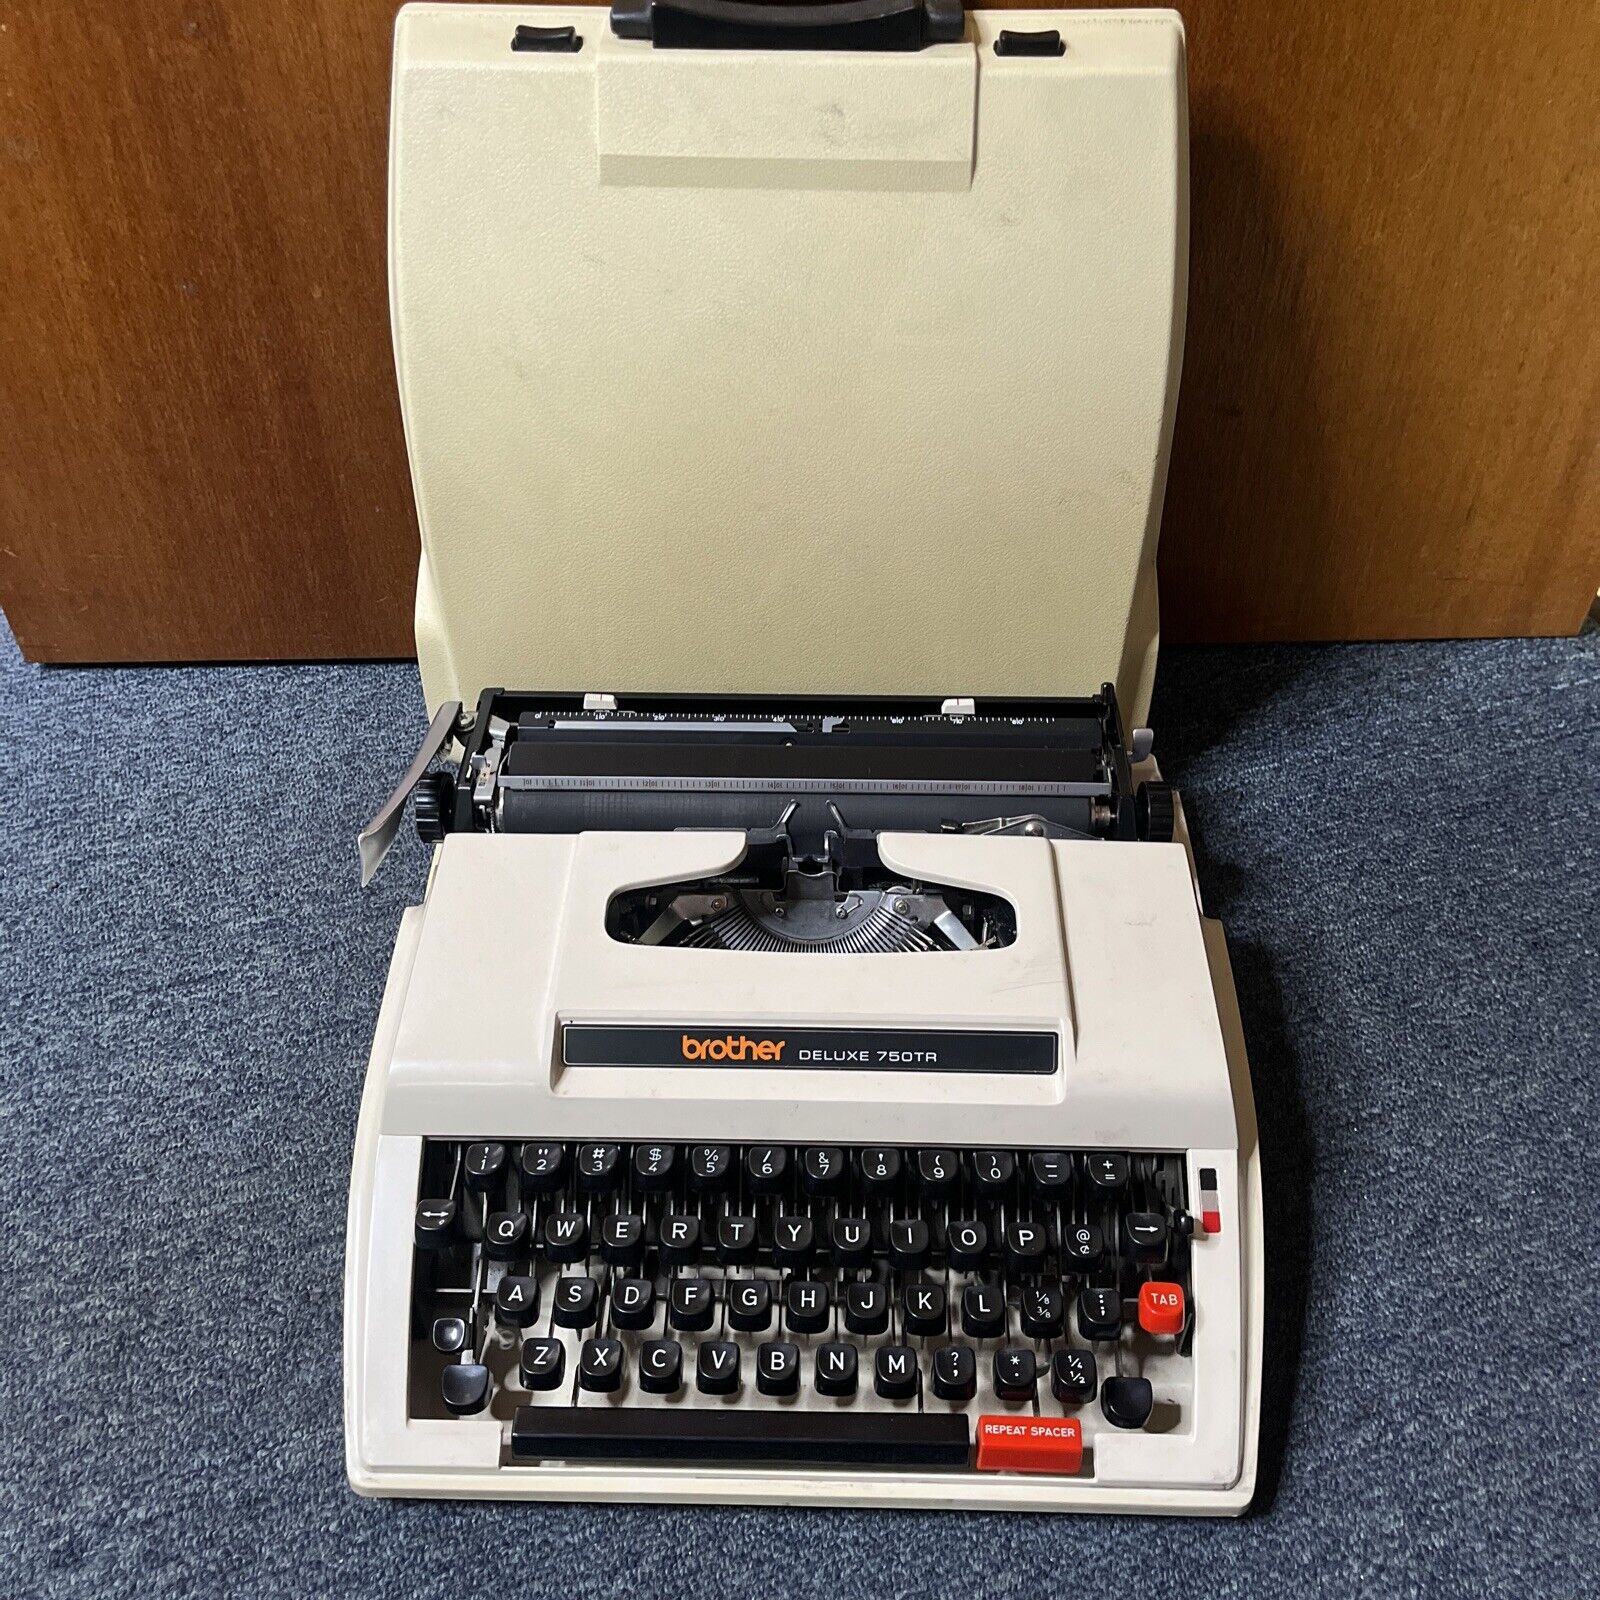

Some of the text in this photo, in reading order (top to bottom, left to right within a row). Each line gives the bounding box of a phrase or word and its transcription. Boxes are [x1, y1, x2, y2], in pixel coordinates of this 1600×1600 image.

[682, 1034, 938, 1063] brother DELUXE 750TR
[649, 1148, 662, 1161] $
[704, 1149, 718, 1161] %
[818, 1152, 830, 1164] &
[536, 1159, 547, 1170] 2
[592, 1161, 603, 1171] 3
[648, 1162, 658, 1172] 4
[706, 1162, 715, 1173] 5
[762, 1163, 773, 1174] 6
[819, 1164, 829, 1175] 7
[876, 1164, 887, 1175] 8
[933, 1168, 945, 1179] 9
[498, 1220, 514, 1237] Q
[556, 1221, 576, 1237] W
[616, 1222, 629, 1238] E
[672, 1222, 687, 1239] R
[731, 1224, 744, 1240] T
[788, 1224, 801, 1241] Y
[845, 1226, 859, 1242] U
[1076, 1229, 1090, 1243] @
[961, 1229, 977, 1246] O
[1018, 1230, 1034, 1246] P
[507, 1285, 523, 1302] A
[568, 1286, 582, 1302] S
[625, 1287, 639, 1304] D
[685, 1288, 697, 1305] F
[742, 1289, 757, 1305] G
[801, 1290, 815, 1308] H
[861, 1291, 873, 1309] J
[918, 1292, 932, 1309] K
[1151, 1292, 1178, 1306] TAB
[978, 1295, 991, 1312] L
[533, 1347, 548, 1365] Z
[593, 1348, 608, 1366] X
[651, 1350, 666, 1368] C
[711, 1351, 726, 1369] V
[770, 1351, 785, 1370] B
[829, 1352, 844, 1370] N
[951, 1352, 959, 1366] ?
[888, 1355, 905, 1374] M
[984, 1424, 1076, 1437] REPEAT SPACER
